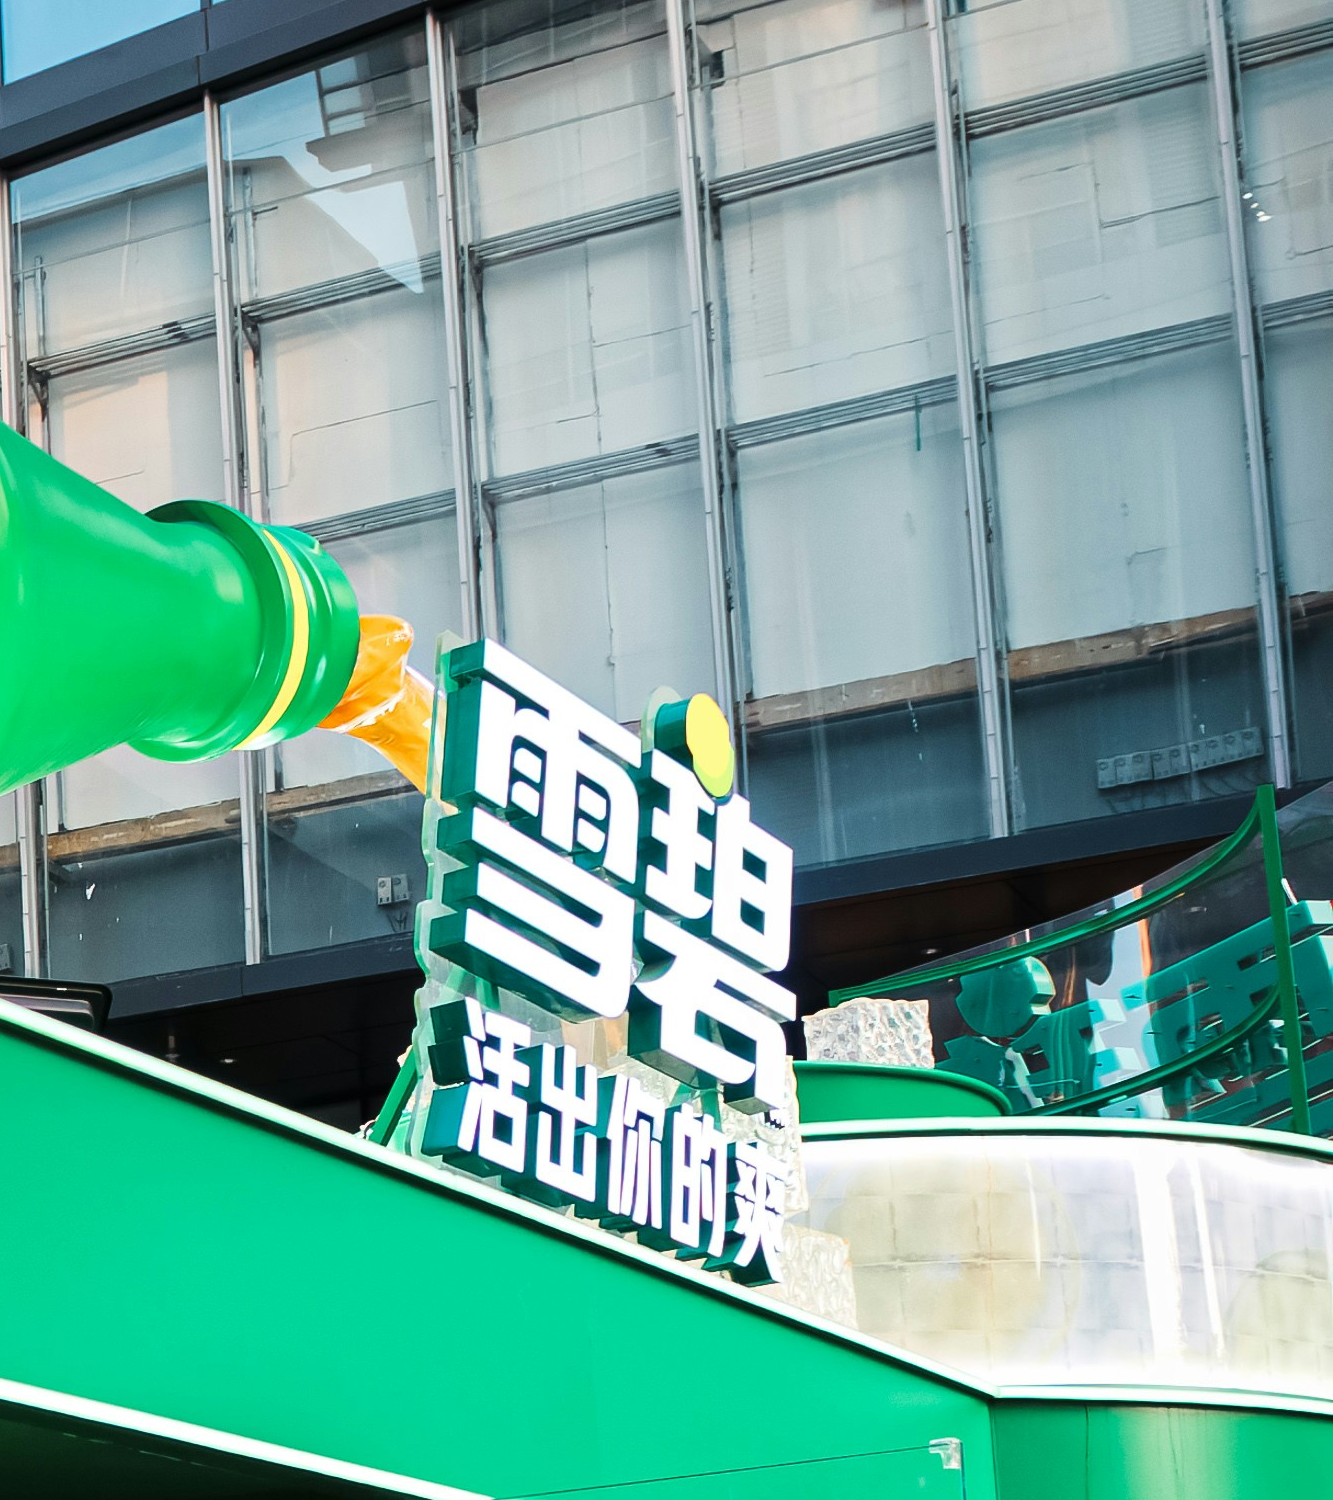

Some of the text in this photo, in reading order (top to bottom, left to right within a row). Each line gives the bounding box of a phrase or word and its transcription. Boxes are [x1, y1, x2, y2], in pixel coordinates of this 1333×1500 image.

[463, 638, 797, 1110] 雪碧
[457, 994, 787, 1283] 活出你的爽
